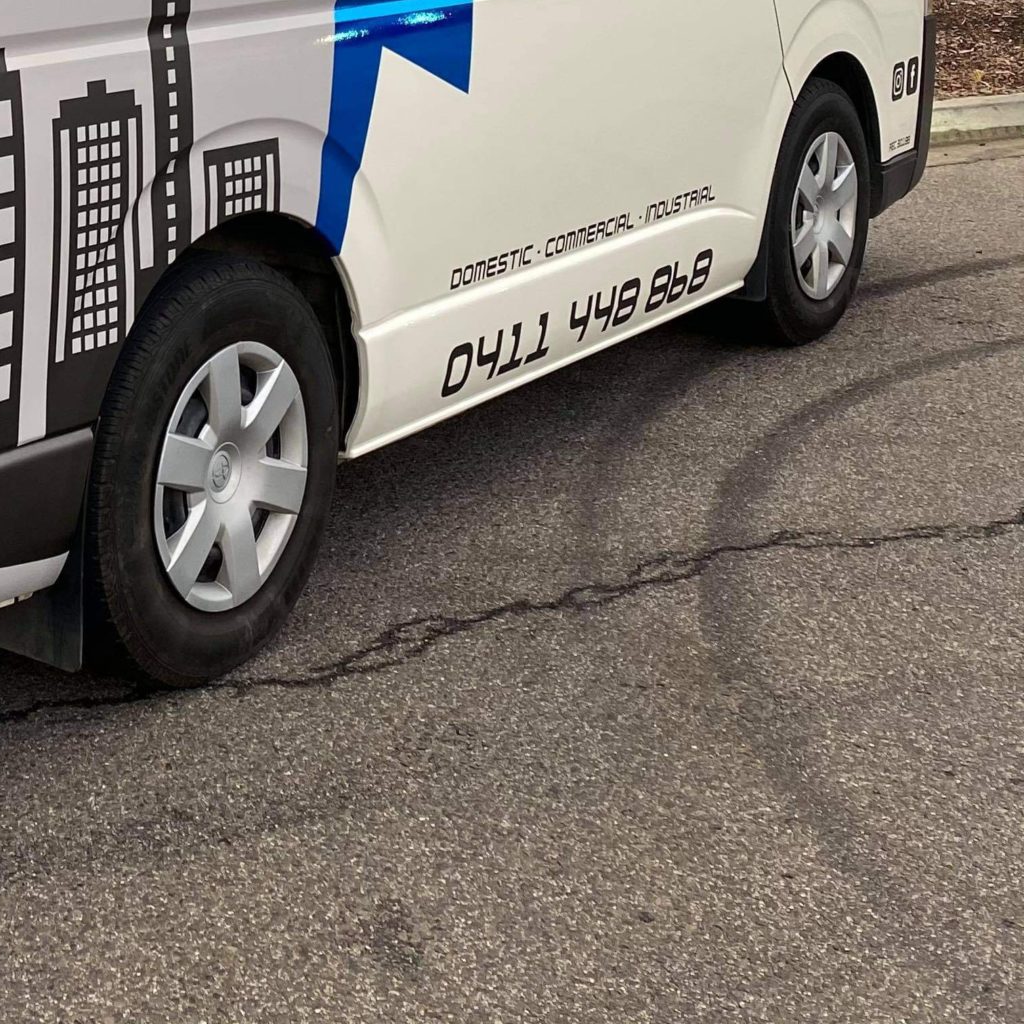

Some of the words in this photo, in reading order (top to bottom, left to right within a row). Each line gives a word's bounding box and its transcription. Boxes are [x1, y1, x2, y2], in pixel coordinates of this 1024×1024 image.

[450, 244, 534, 290] DOMESTIC
[544, 211, 634, 258] COMMERCIAL
[644, 184, 715, 224] INDUSTRIAL
[441, 312, 550, 398] 0411
[569, 277, 641, 342] 448
[644, 248, 713, 313] 868
